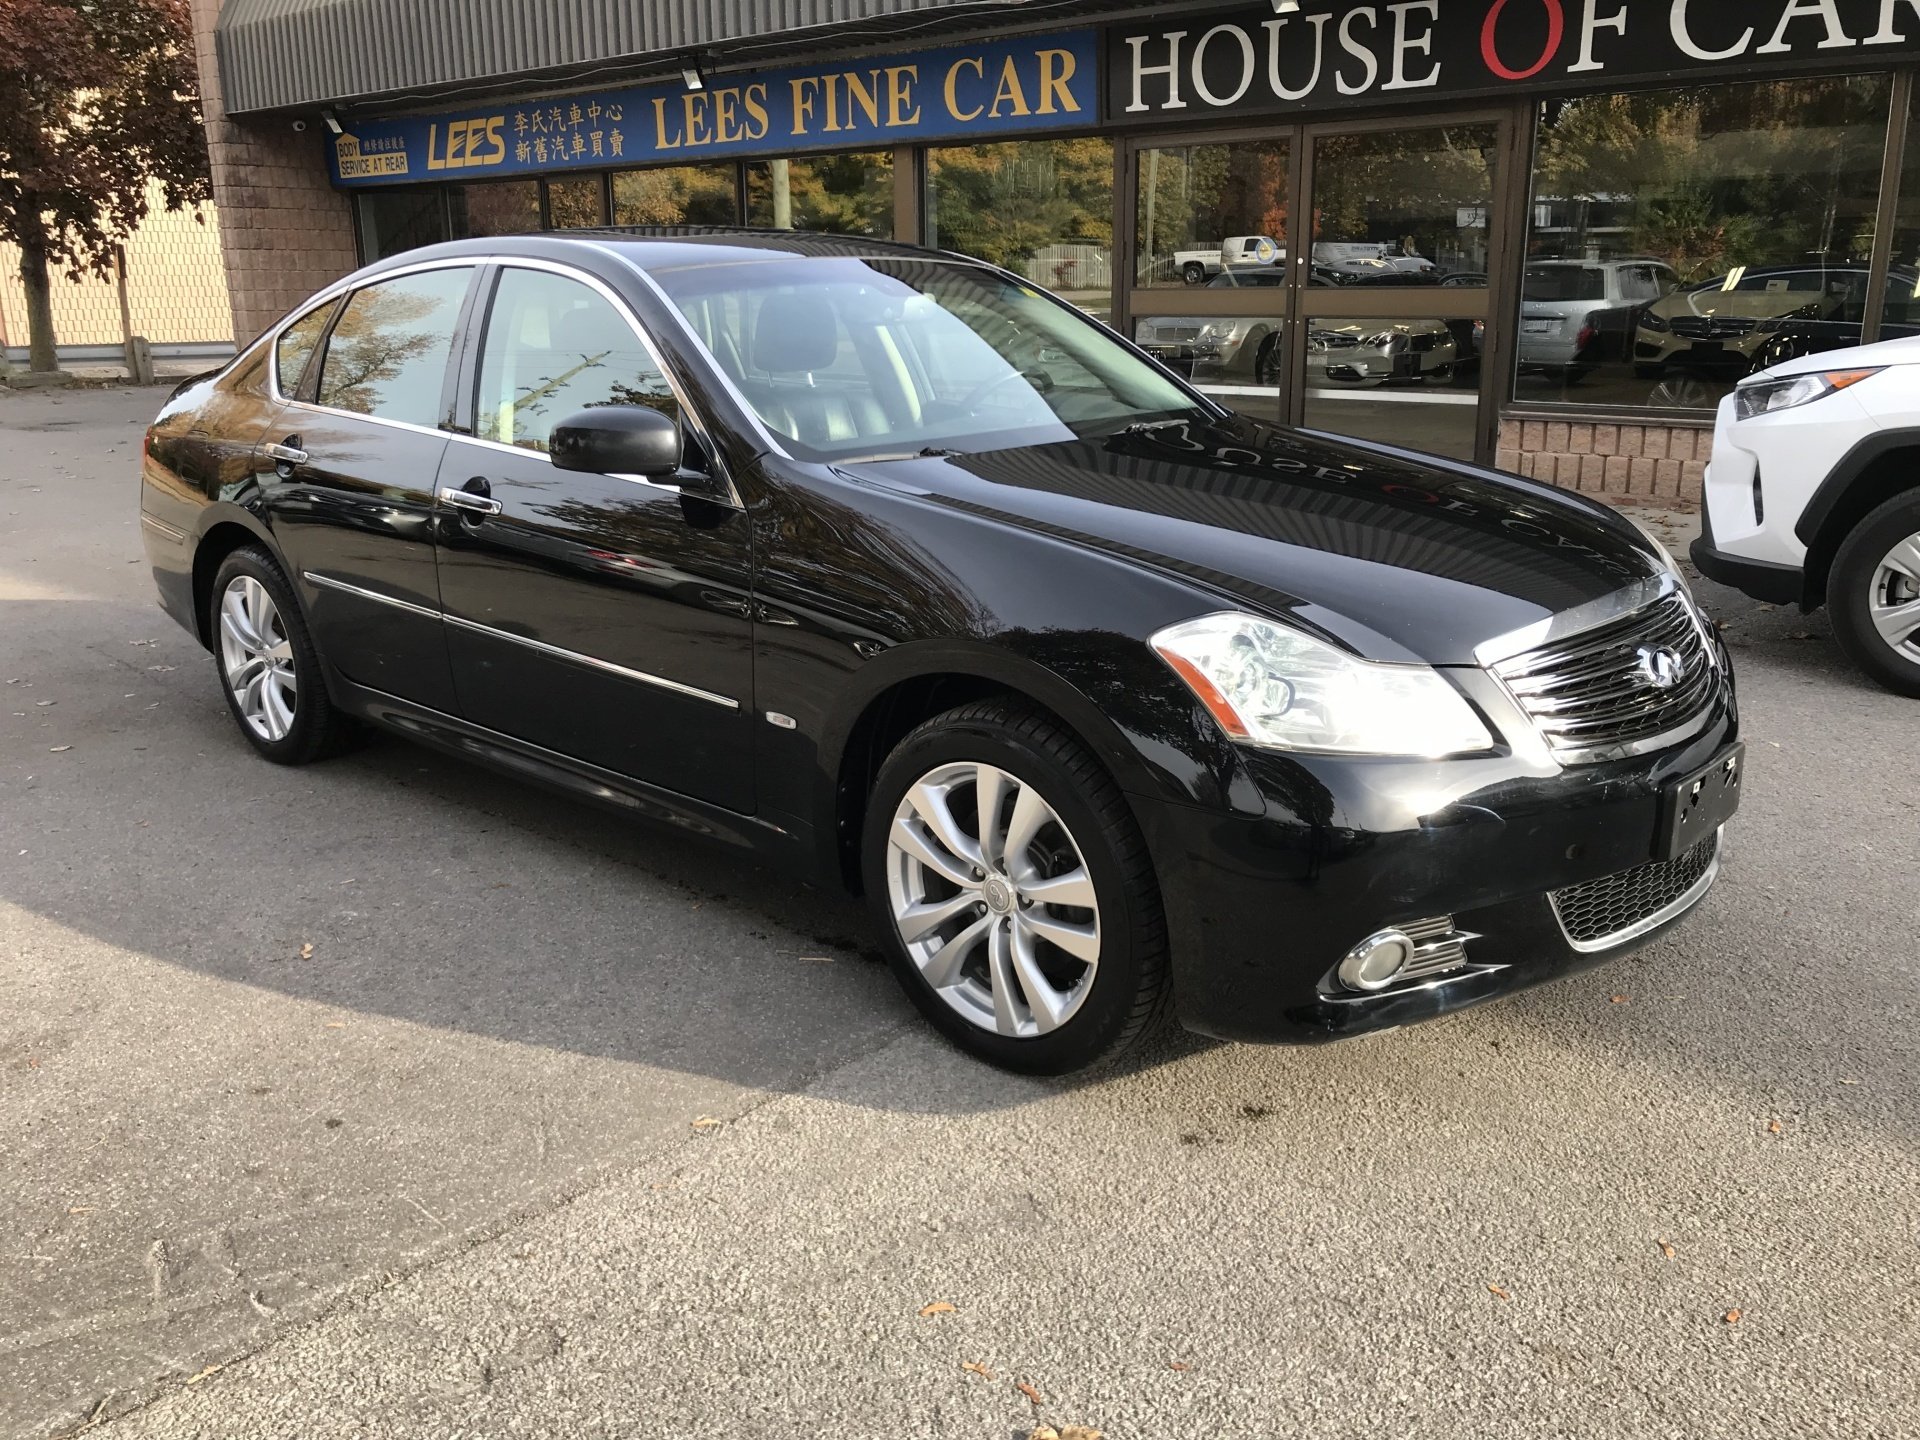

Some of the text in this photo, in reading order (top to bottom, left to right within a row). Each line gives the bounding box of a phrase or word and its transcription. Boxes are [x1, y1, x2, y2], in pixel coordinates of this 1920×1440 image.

[1125, 0, 1441, 112] HOUSE
[1480, 0, 1628, 80] OF
[652, 48, 1081, 150] LEES FINE CAR
[514, 100, 623, 137] 李氏汽車中心
[338, 142, 358, 157] BODY
[427, 115, 505, 170] LEES
[515, 128, 625, 164] 新舊汽車買賣
[341, 156, 406, 175] SERVICE AT REAR
